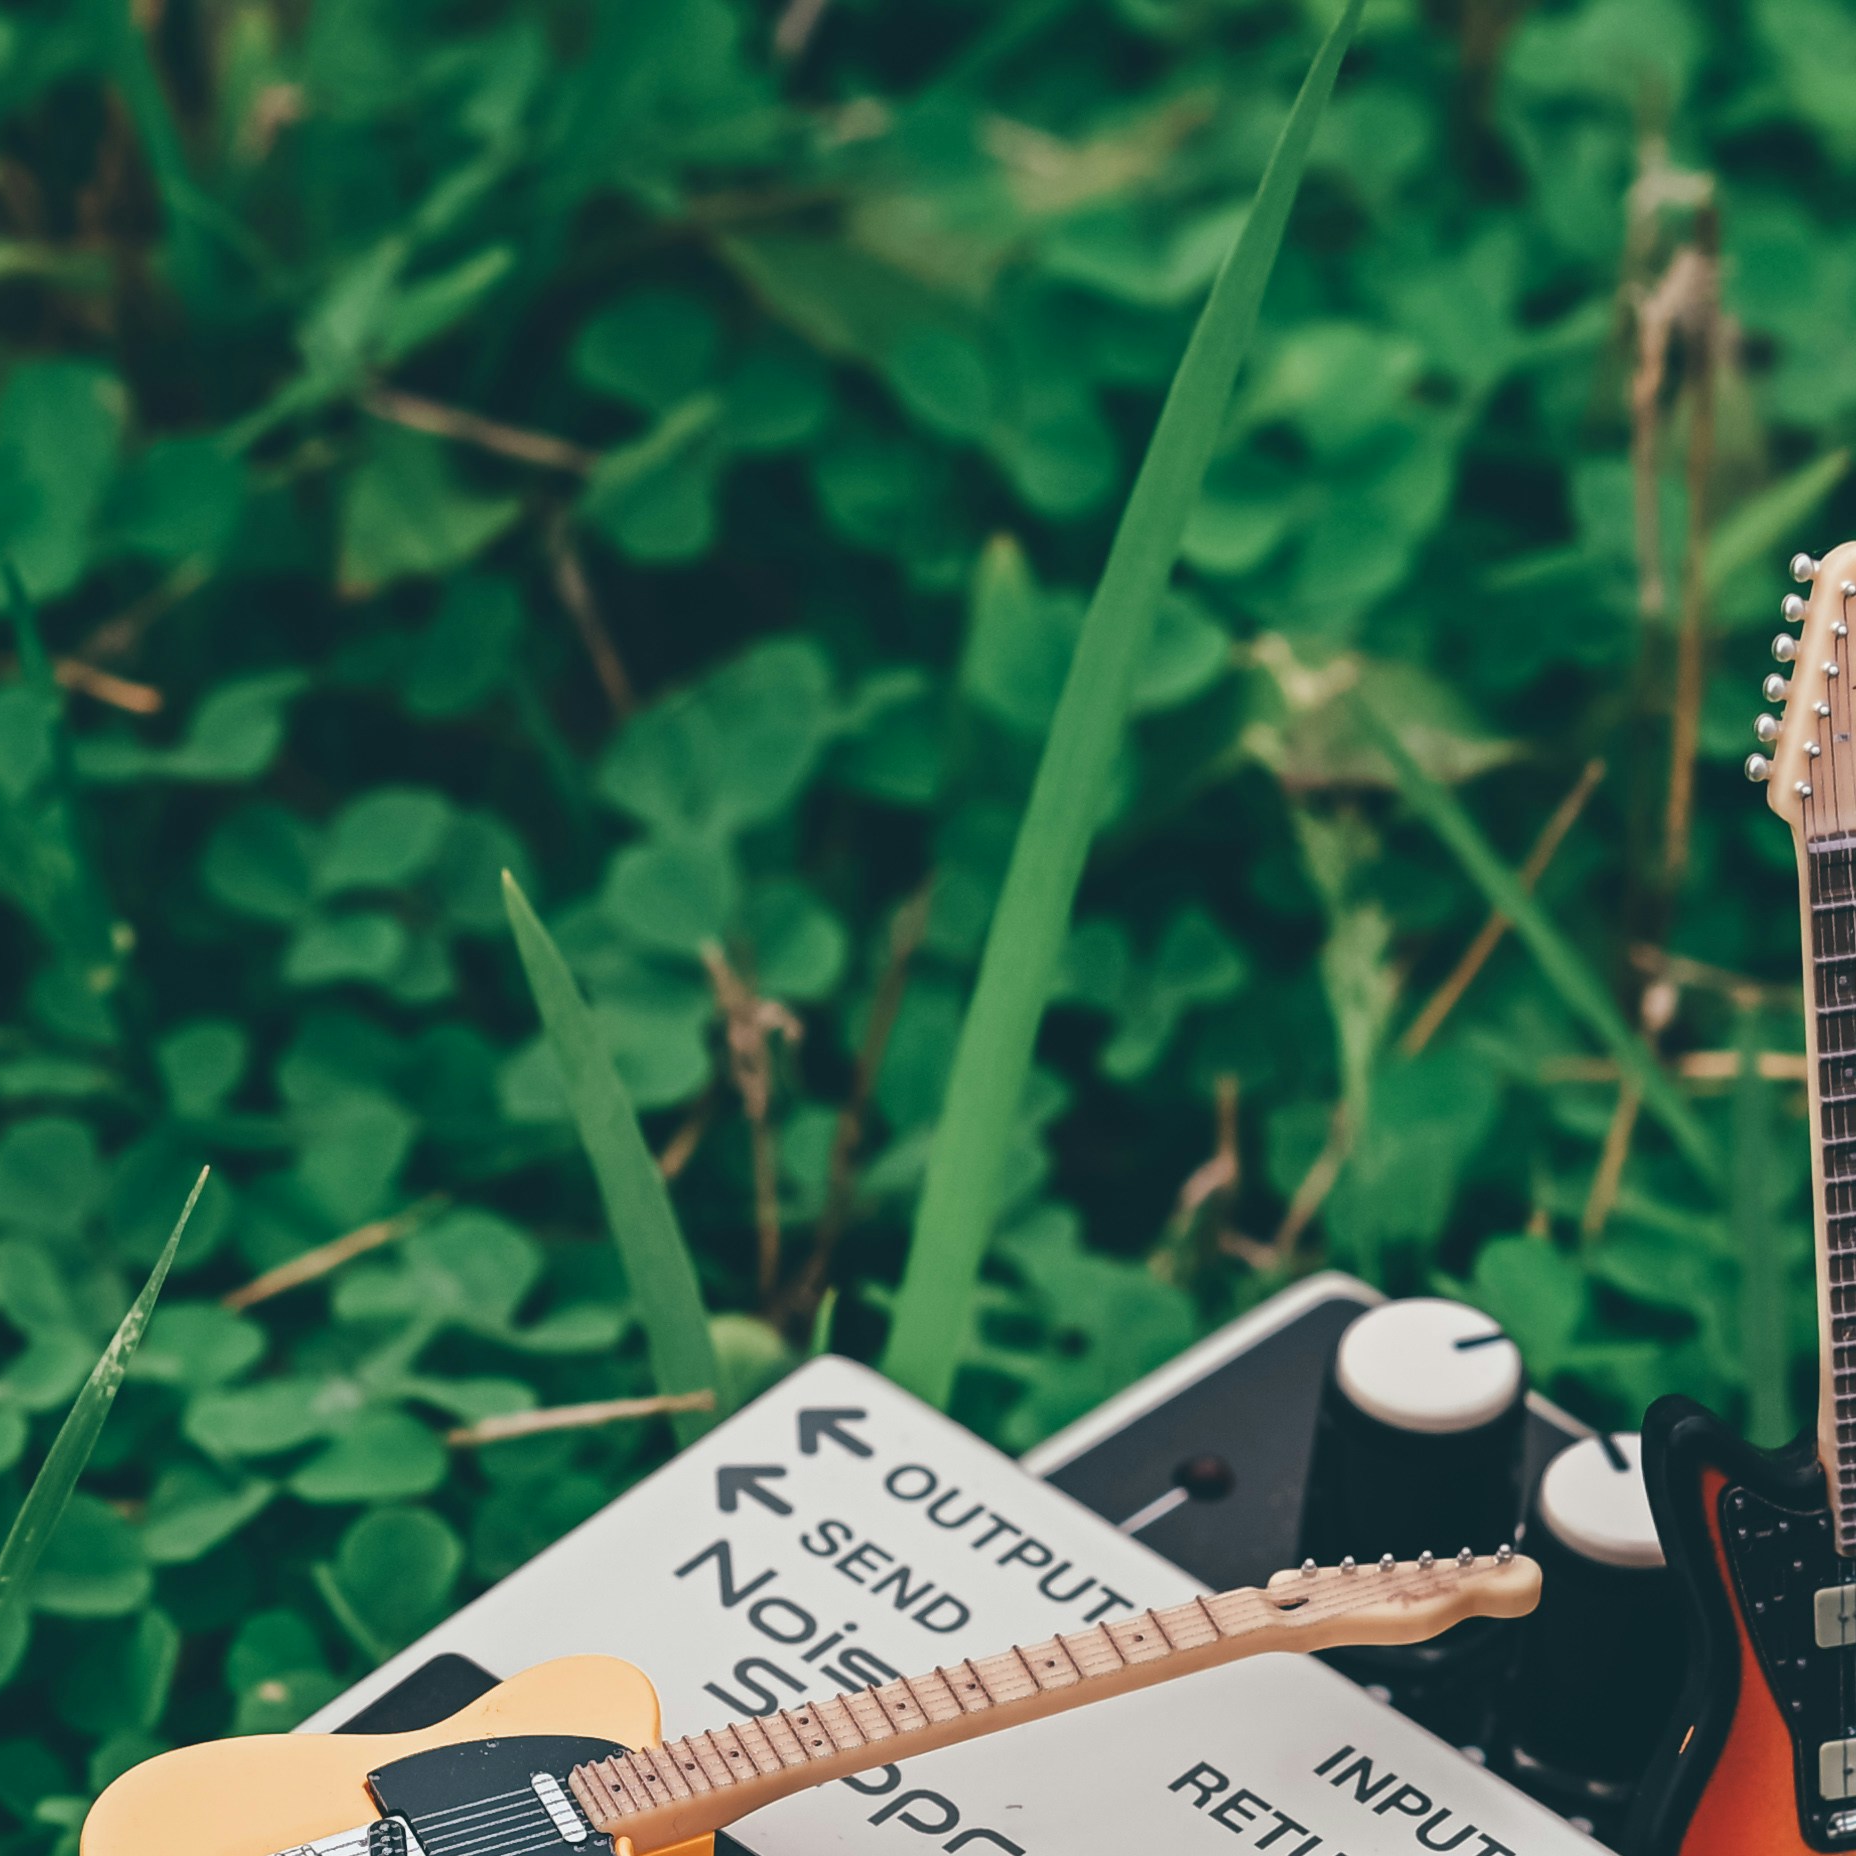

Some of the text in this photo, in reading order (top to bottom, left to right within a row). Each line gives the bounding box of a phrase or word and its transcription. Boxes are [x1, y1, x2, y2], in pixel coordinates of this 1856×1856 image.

[673, 1539, 903, 1694] Nois
[800, 1519, 971, 1634] SEND
[884, 1464, 1135, 1624] OUTPUT
